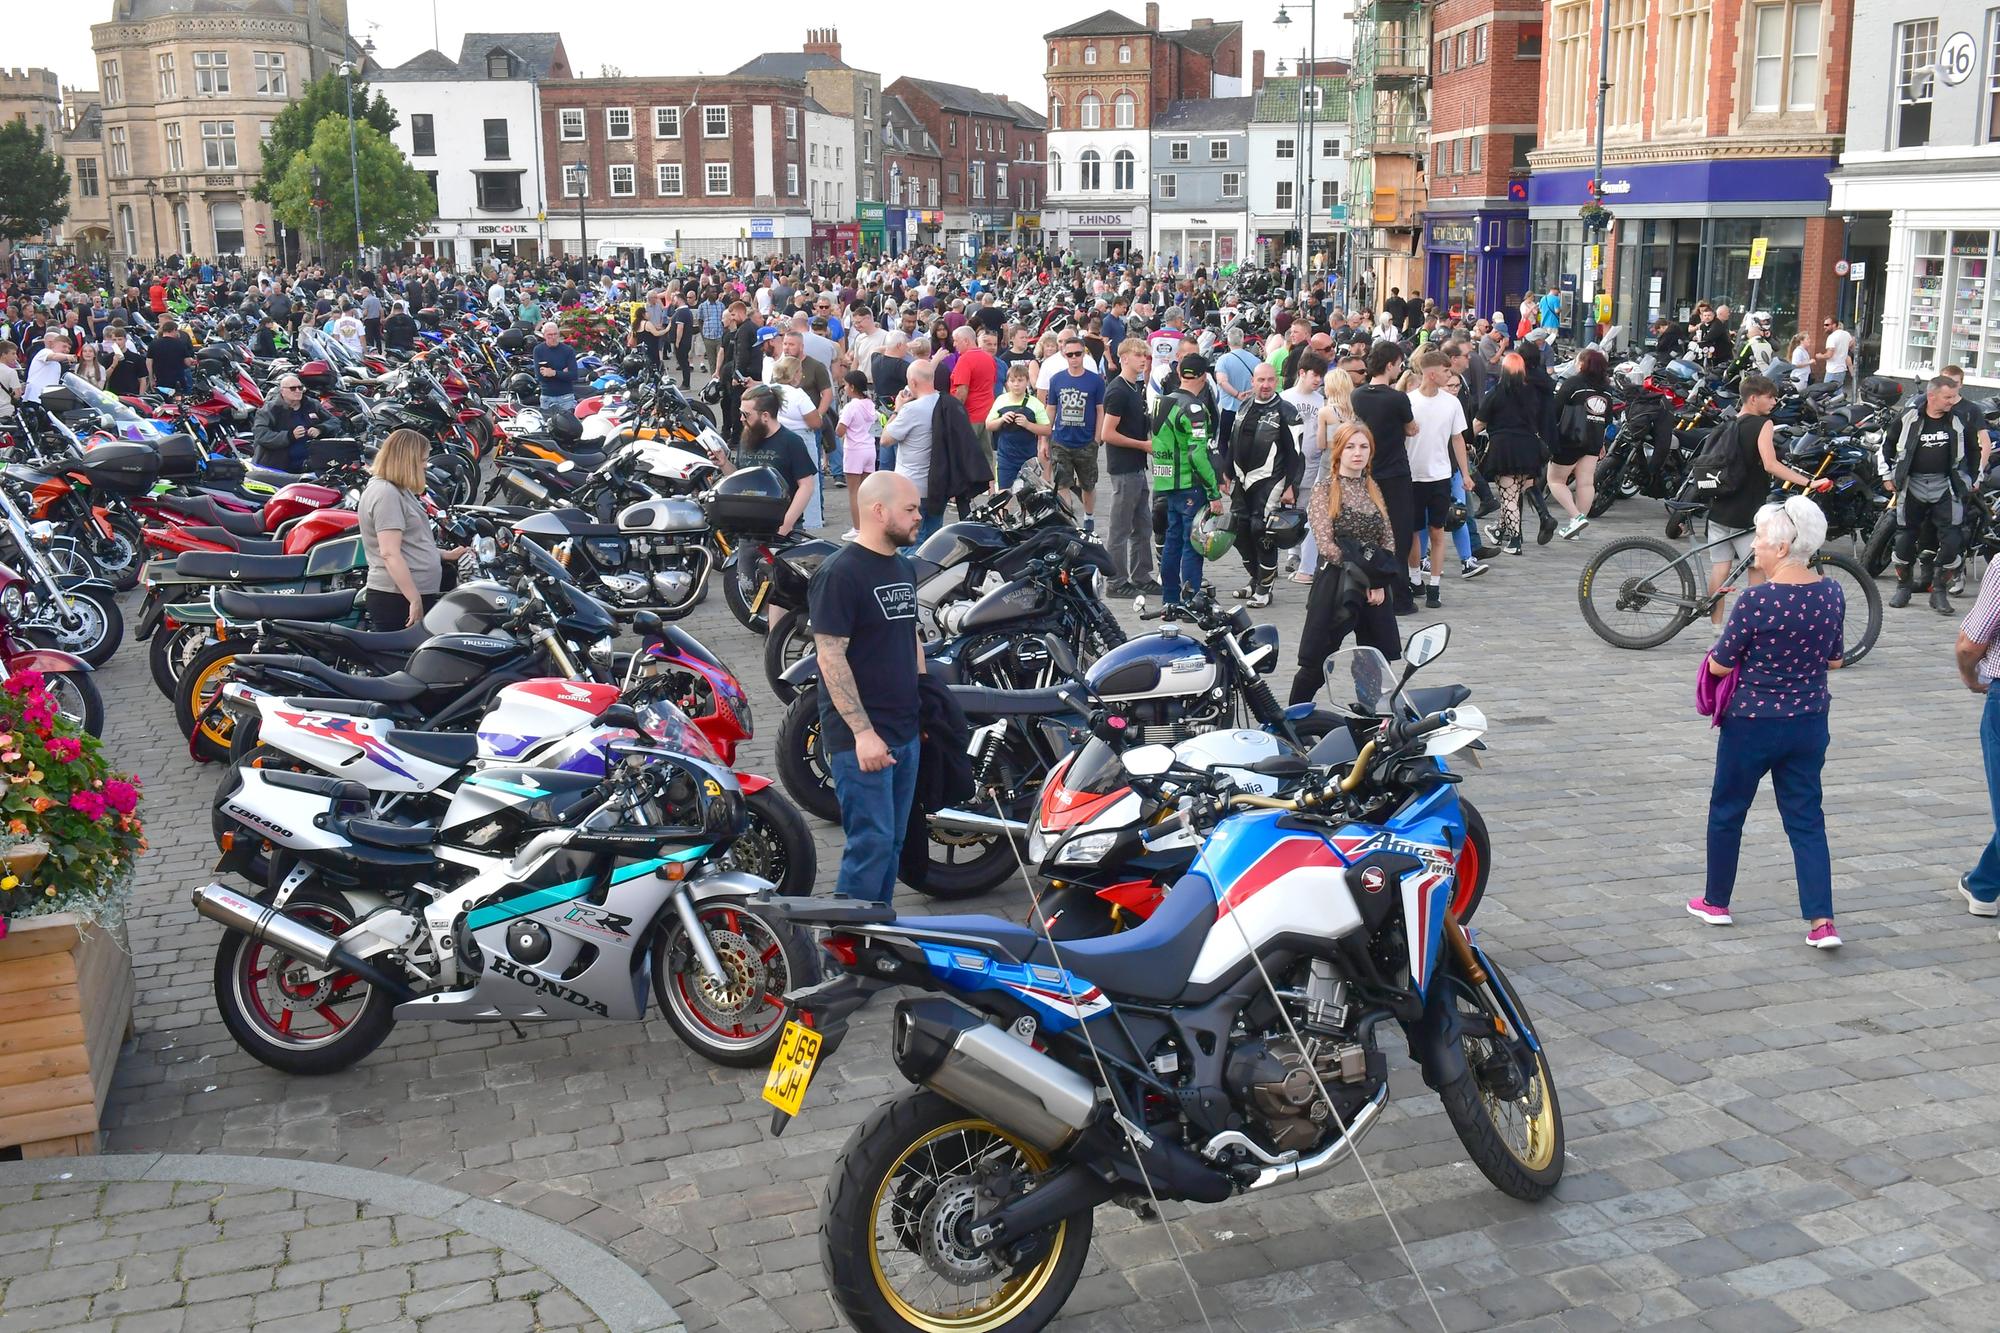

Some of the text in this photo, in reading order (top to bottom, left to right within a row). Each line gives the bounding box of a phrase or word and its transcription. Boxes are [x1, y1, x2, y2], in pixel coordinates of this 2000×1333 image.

[1948, 43, 1969, 74] 16
[1079, 215, 1121, 225] F.HINDS
[478, 225, 528, 233] HSBC UK
[1432, 227, 1446, 241] NEW
[1060, 392, 1088, 408] 1985
[1920, 431, 1949, 441] aprilia
[295, 495, 320, 508] YAMAHA
[887, 588, 911, 602] VANS
[462, 639, 506, 649] TRIUMPH
[557, 694, 592, 704] HONDA
[1240, 782, 1264, 794] ilia
[228, 804, 294, 838] CBR400
[1353, 832, 1434, 857] Africa
[489, 955, 610, 1018] HONDA
[778, 1028, 818, 1069] FJ69
[771, 1062, 803, 1103] XJH
